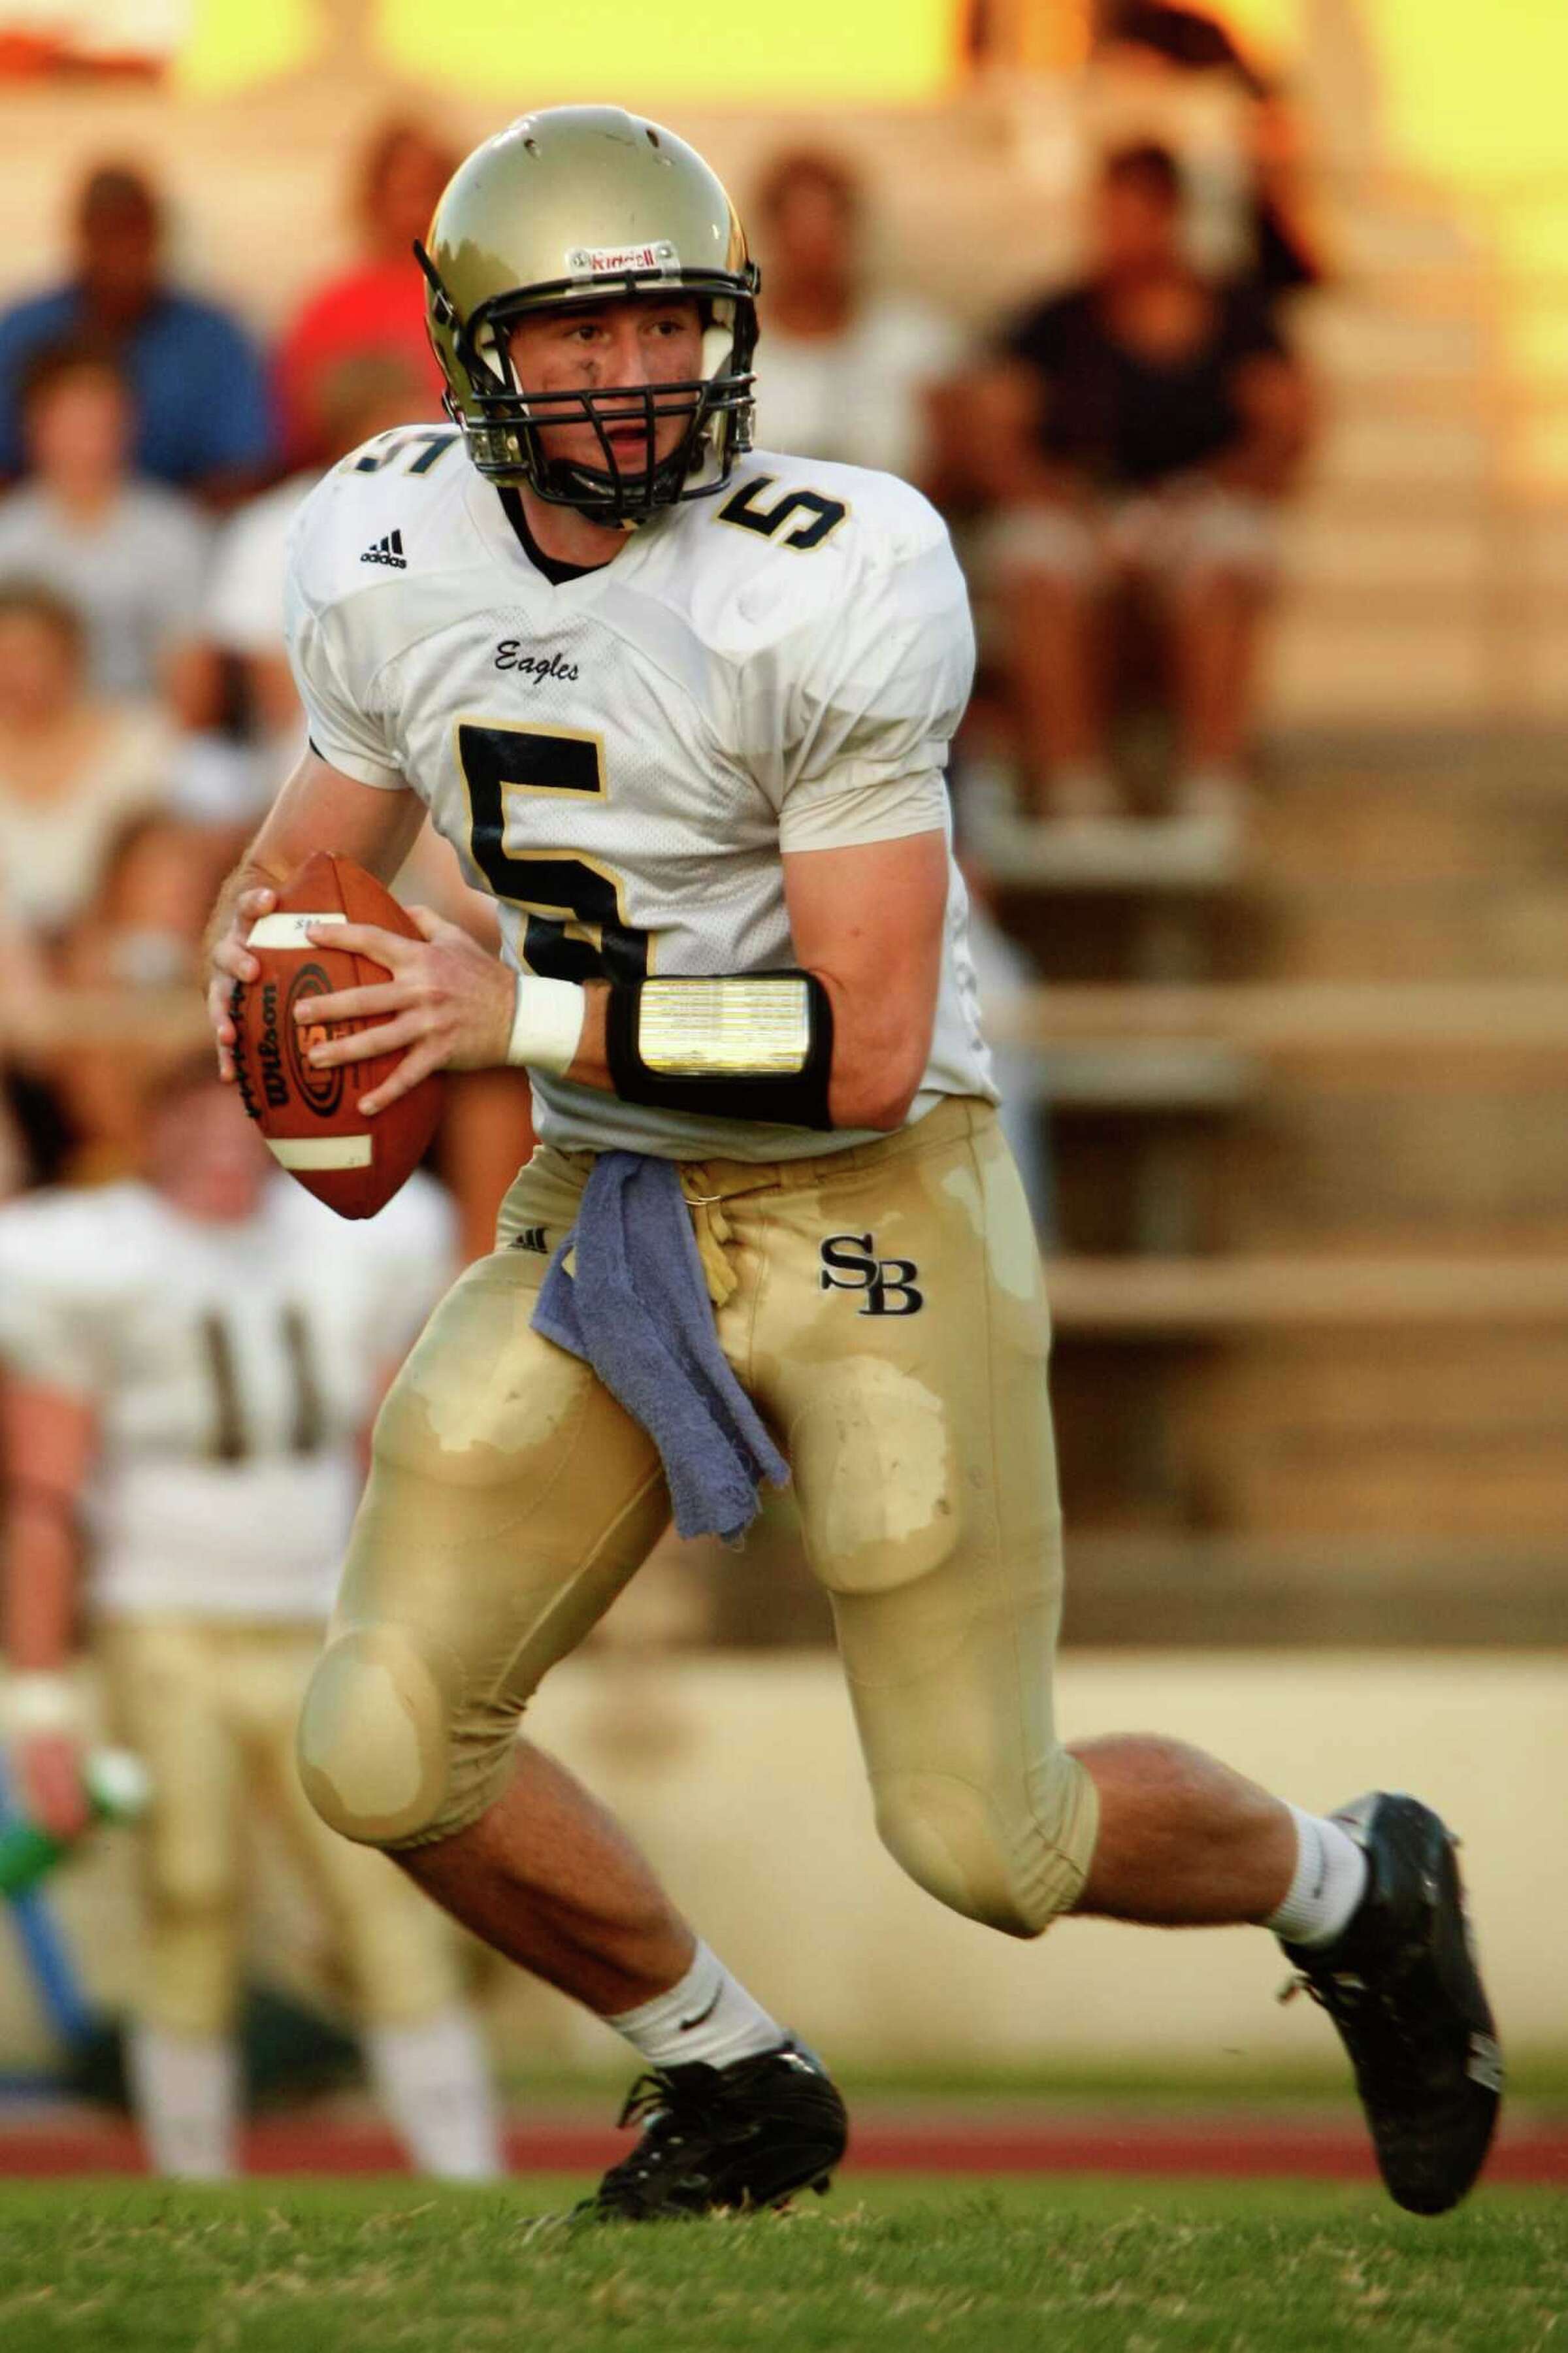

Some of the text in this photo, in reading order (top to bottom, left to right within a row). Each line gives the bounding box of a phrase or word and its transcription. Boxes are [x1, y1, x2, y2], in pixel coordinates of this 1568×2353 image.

[713, 473, 850, 555] 5
[360, 553, 408, 569] adidas
[495, 640, 579, 685] Eagles
[453, 716, 656, 988] 5
[258, 985, 290, 1108] Wilson
[821, 1232, 924, 1316] SB
